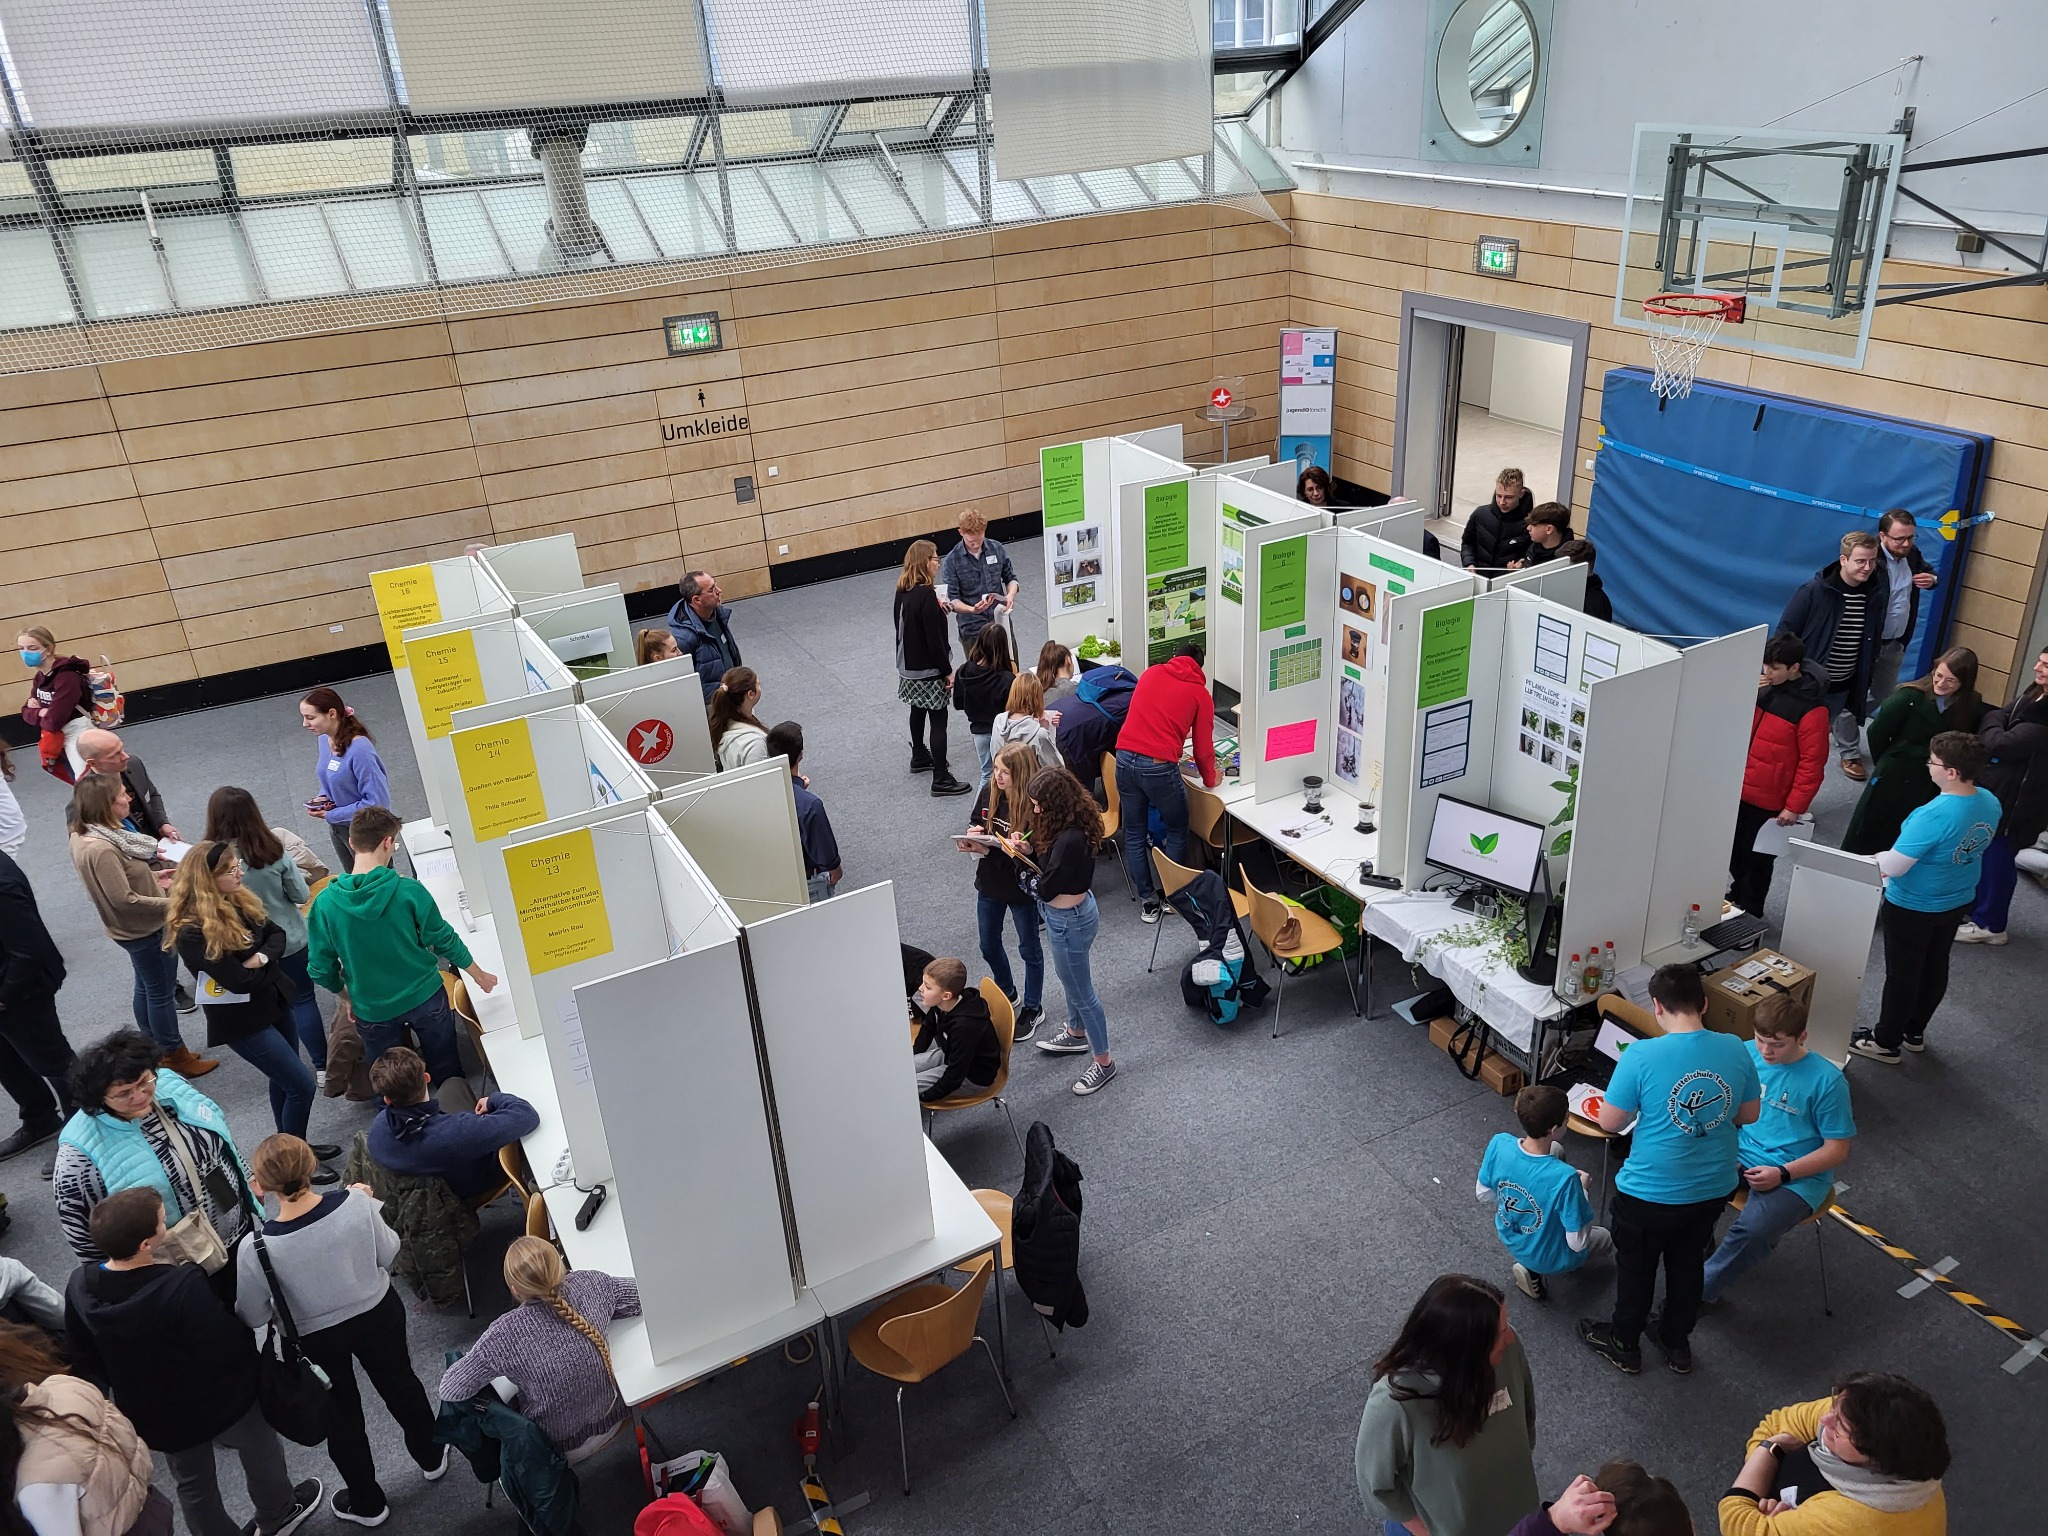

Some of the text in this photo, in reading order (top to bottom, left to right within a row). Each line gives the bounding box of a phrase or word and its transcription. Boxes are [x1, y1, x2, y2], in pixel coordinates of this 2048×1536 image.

[662, 414, 749, 441] Umkleide
[1156, 494, 1177, 503] Biologie
[1272, 550, 1296, 561] Biologie
[389, 579, 418, 589] Chemie
[1435, 616, 1460, 628] Biologie
[1445, 627, 1450, 635] 5
[426, 647, 457, 658] Chemie
[438, 657, 449, 665] 15
[1525, 678, 1560, 700] PFLANZLICHE
[1524, 686, 1560, 707] LUFTREINIGER
[475, 738, 510, 752] Chemie
[488, 749, 501, 759] 14
[530, 851, 571, 868] Chemie
[546, 865, 560, 876] 13
[572, 885, 587, 895] zum
[519, 889, 600, 916] Mindesthaltbarkeitsdat
[522, 915, 534, 923] um
[535, 910, 547, 919] bei
[571, 923, 584, 931] Rau
[1671, 1070, 1714, 1097] Mittelschule
